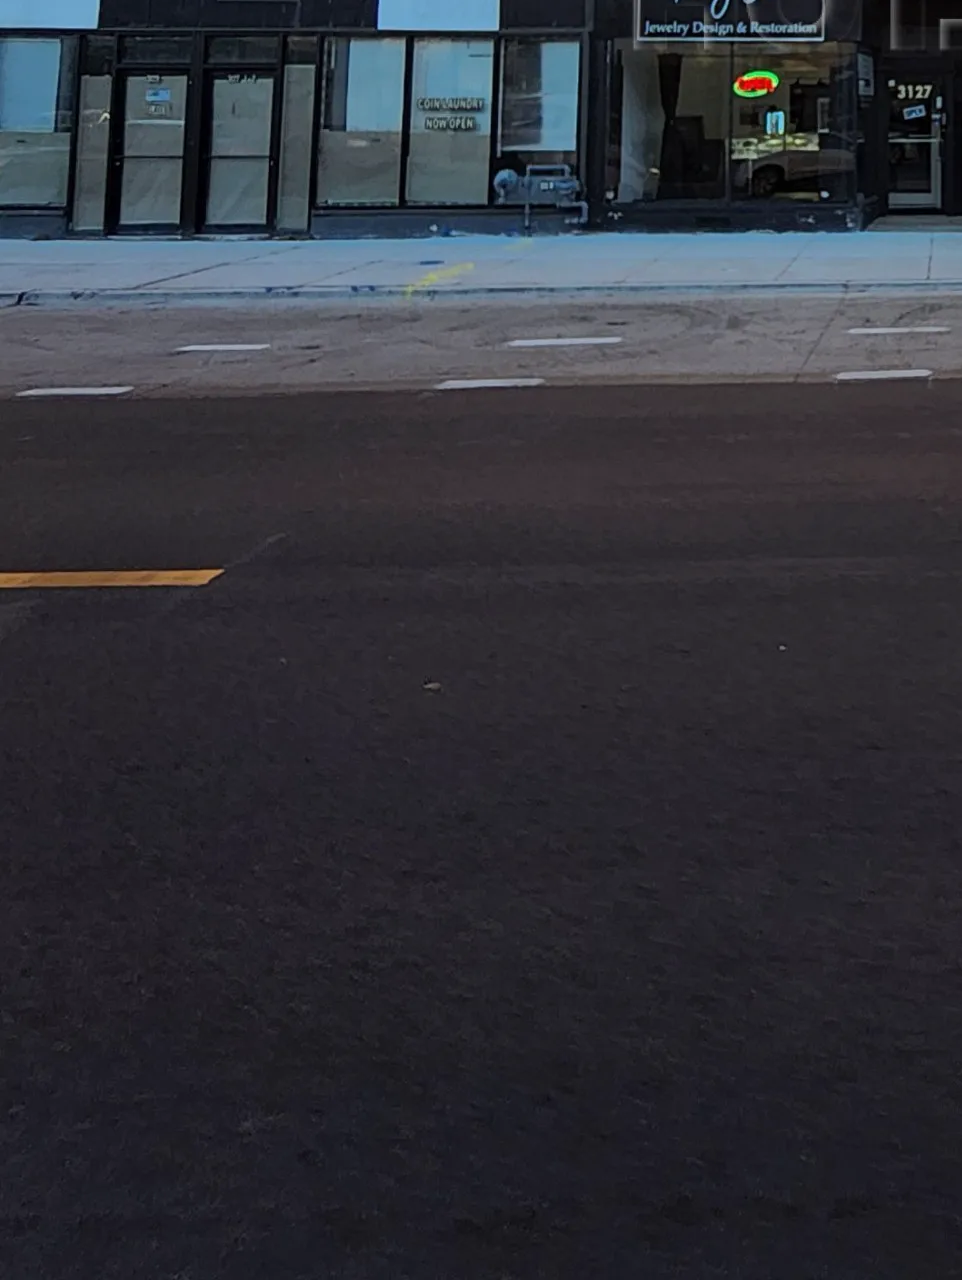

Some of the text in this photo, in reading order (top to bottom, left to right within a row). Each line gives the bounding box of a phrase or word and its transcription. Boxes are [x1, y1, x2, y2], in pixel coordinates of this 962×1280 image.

[644, 21, 818, 36] Jewelry Design & Restoration
[897, 84, 932, 99] 3127
[417, 98, 483, 110] COIN LAUNDRY
[426, 117, 474, 130] NOW OPEN
